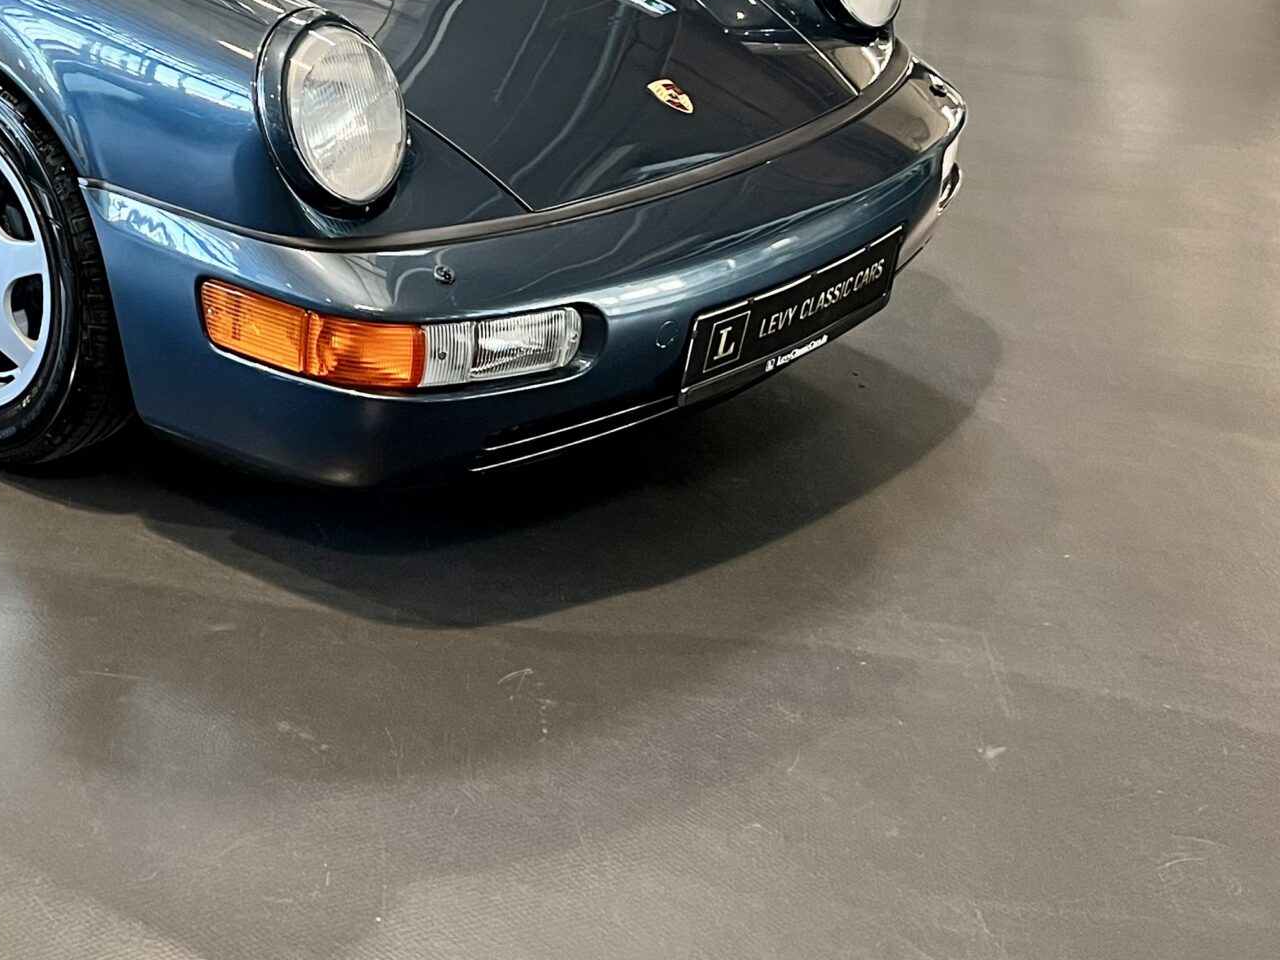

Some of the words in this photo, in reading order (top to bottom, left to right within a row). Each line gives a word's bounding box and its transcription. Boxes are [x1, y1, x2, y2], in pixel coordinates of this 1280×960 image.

[713, 326, 735, 360] L
[759, 301, 799, 338] LEVY
[799, 276, 855, 320] CLASSIC
[852, 258, 885, 292] CARS
